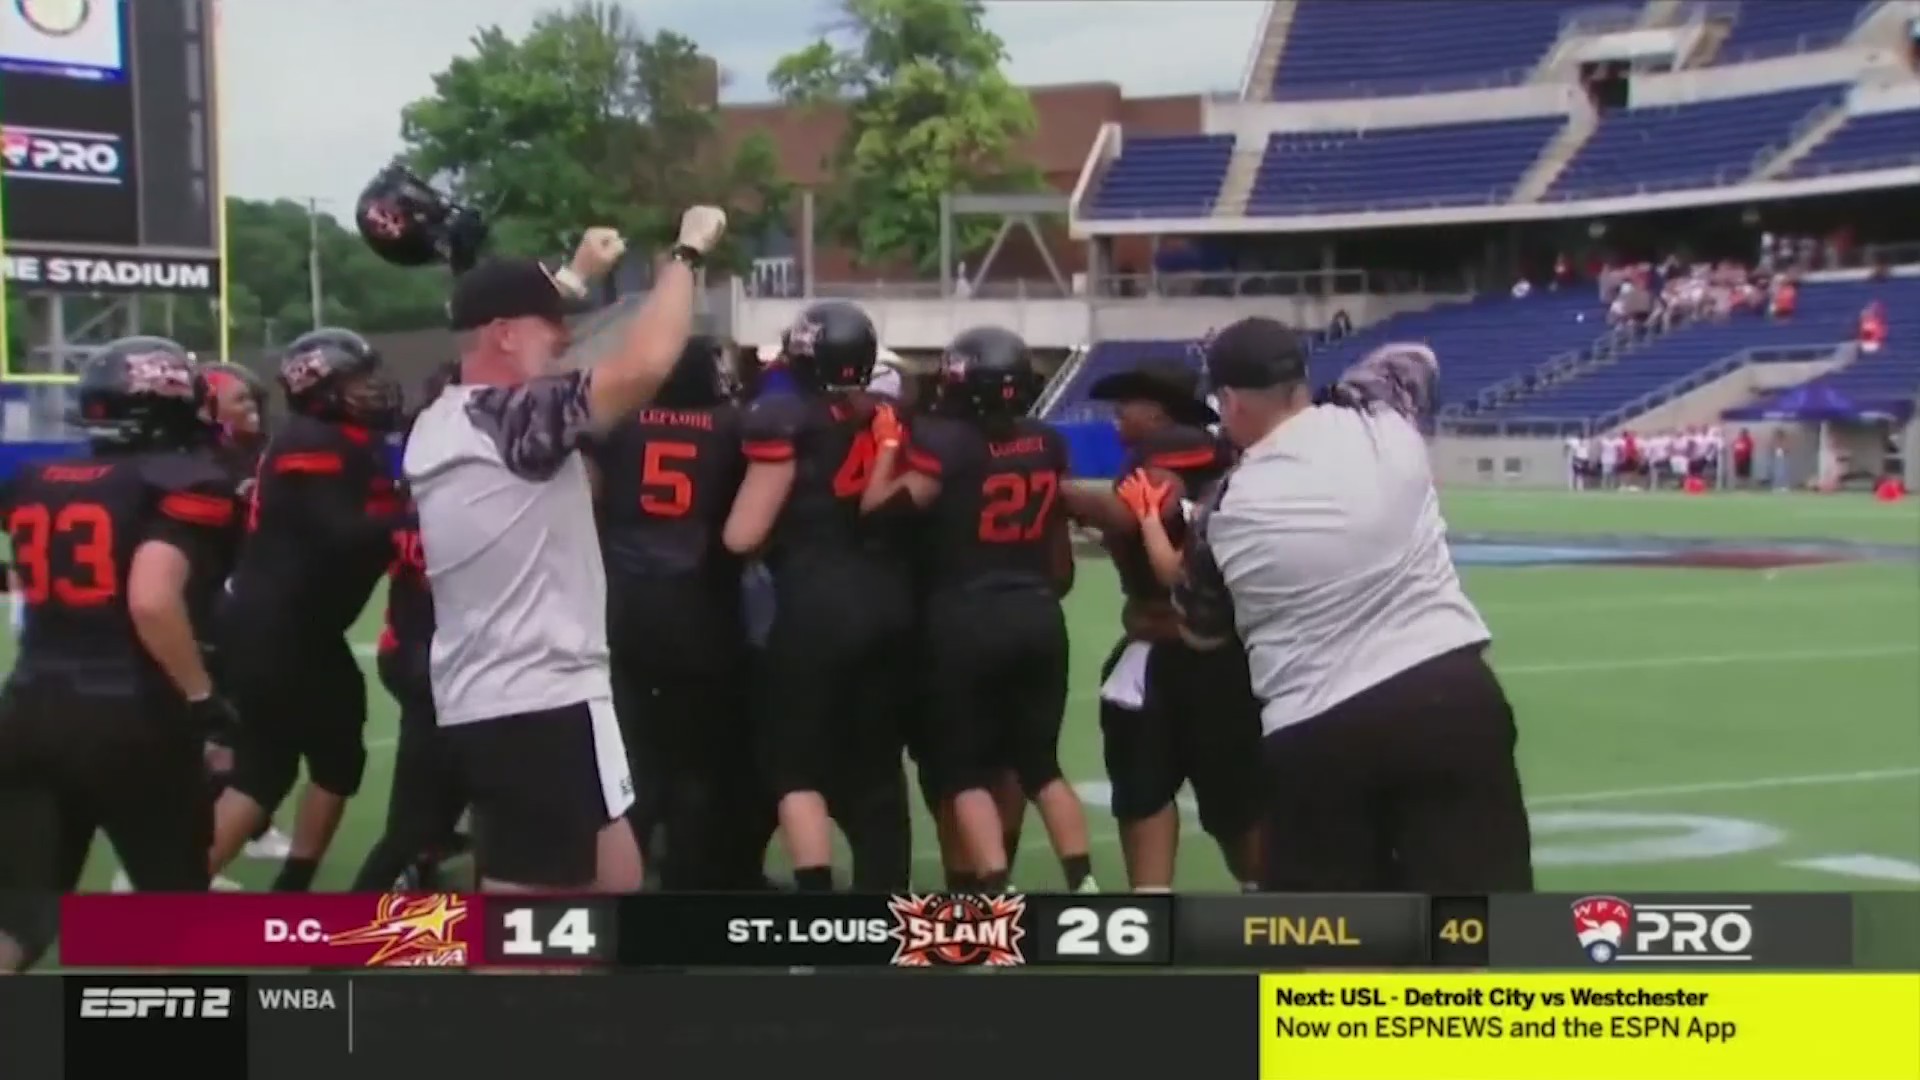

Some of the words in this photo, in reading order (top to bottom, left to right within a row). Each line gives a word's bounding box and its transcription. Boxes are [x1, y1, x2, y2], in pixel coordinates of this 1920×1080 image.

[31, 139, 119, 174] PRO
[46, 258, 210, 288] STADIUM
[641, 440, 698, 517] 5
[979, 470, 1057, 542] 27
[9, 501, 117, 606] 33
